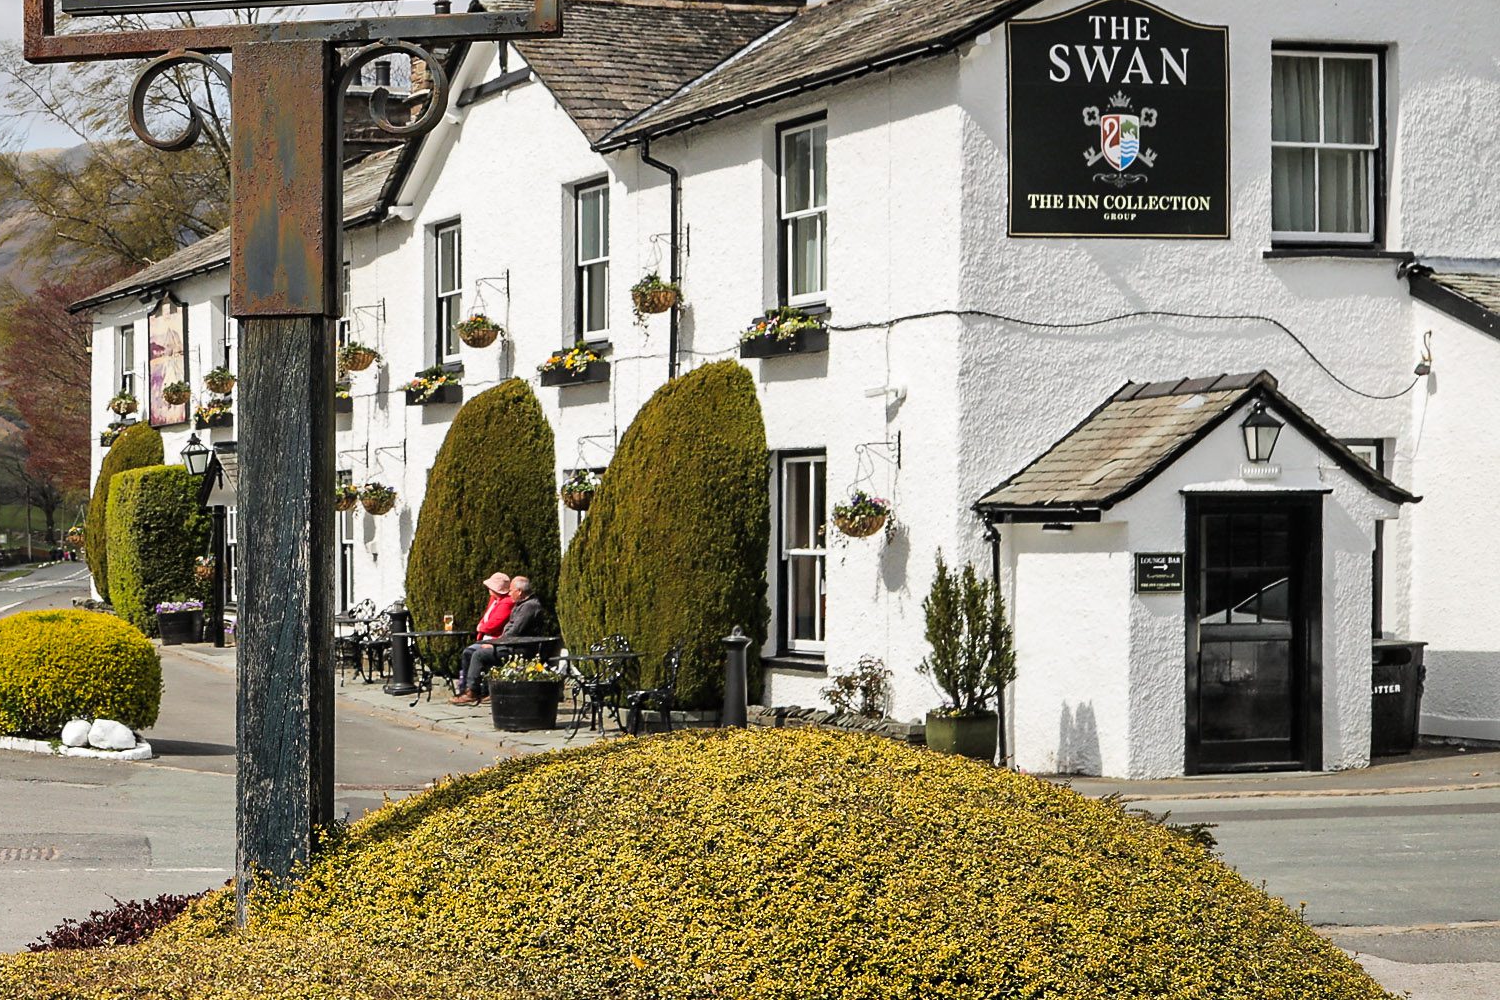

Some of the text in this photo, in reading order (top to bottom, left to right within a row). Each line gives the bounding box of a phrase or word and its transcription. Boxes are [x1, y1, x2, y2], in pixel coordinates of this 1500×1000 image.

[1088, 15, 1151, 41] THE
[1049, 43, 1190, 86] SWAN
[1027, 193, 1211, 211] THE INN COLLECTION
[1103, 212, 1137, 221] GROUP
[1372, 684, 1401, 694] ITTER
